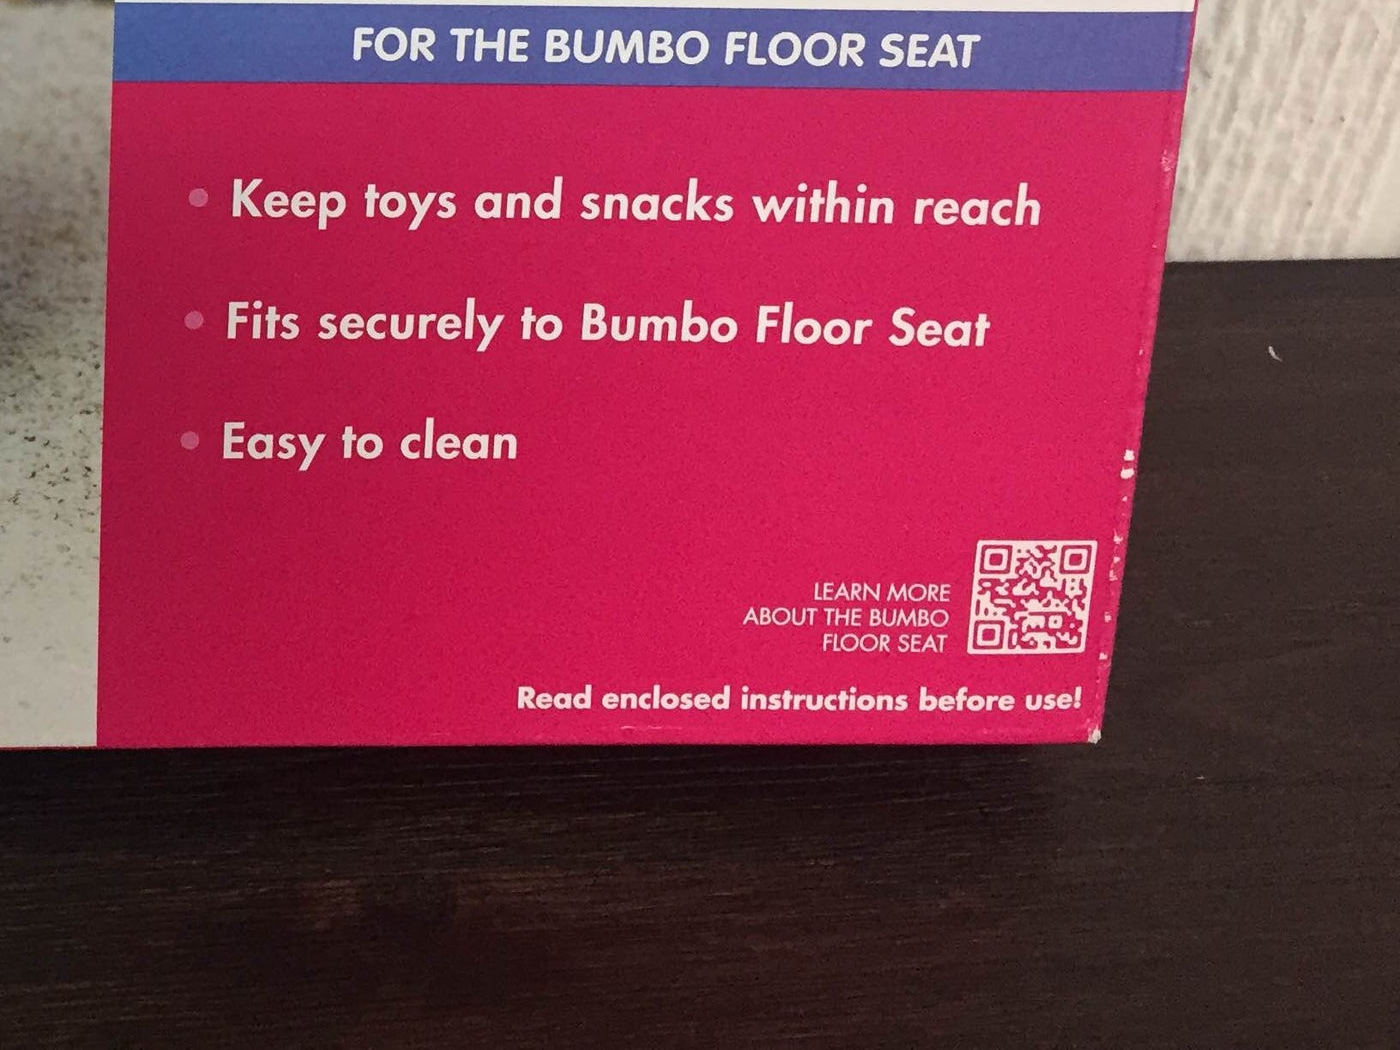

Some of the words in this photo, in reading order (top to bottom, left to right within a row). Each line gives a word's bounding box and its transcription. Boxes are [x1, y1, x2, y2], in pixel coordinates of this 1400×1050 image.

[353, 27, 435, 61] FOR
[450, 28, 529, 62] THE
[545, 29, 709, 64] BUMBO
[725, 32, 865, 67] FLOOR
[879, 33, 981, 68] SEAT
[233, 179, 346, 230] Keep
[365, 184, 456, 230] toys
[475, 176, 563, 219] and
[581, 178, 733, 221] snacks
[752, 180, 894, 223] within
[914, 183, 1040, 226] reach
[228, 301, 299, 339] Fits
[318, 298, 504, 351] securely
[521, 307, 562, 340] to
[582, 300, 737, 342] Bumbo
[757, 302, 872, 344] Floor
[889, 307, 990, 346] Seat
[223, 422, 325, 471] Easy
[342, 426, 383, 459] to
[401, 418, 517, 459] clean
[815, 582, 880, 601] LEARN
[887, 583, 950, 601] MORE
[743, 607, 818, 625] ABOUT
[824, 608, 862, 626] THE
[870, 609, 949, 627] BUMBO
[823, 634, 890, 652] FLOOR
[898, 634, 948, 652] SEAT
[518, 685, 591, 709] Read
[602, 685, 730, 709] enclosed
[742, 686, 908, 711] instructions
[919, 687, 1015, 711] before
[1026, 686, 1081, 710] use!
